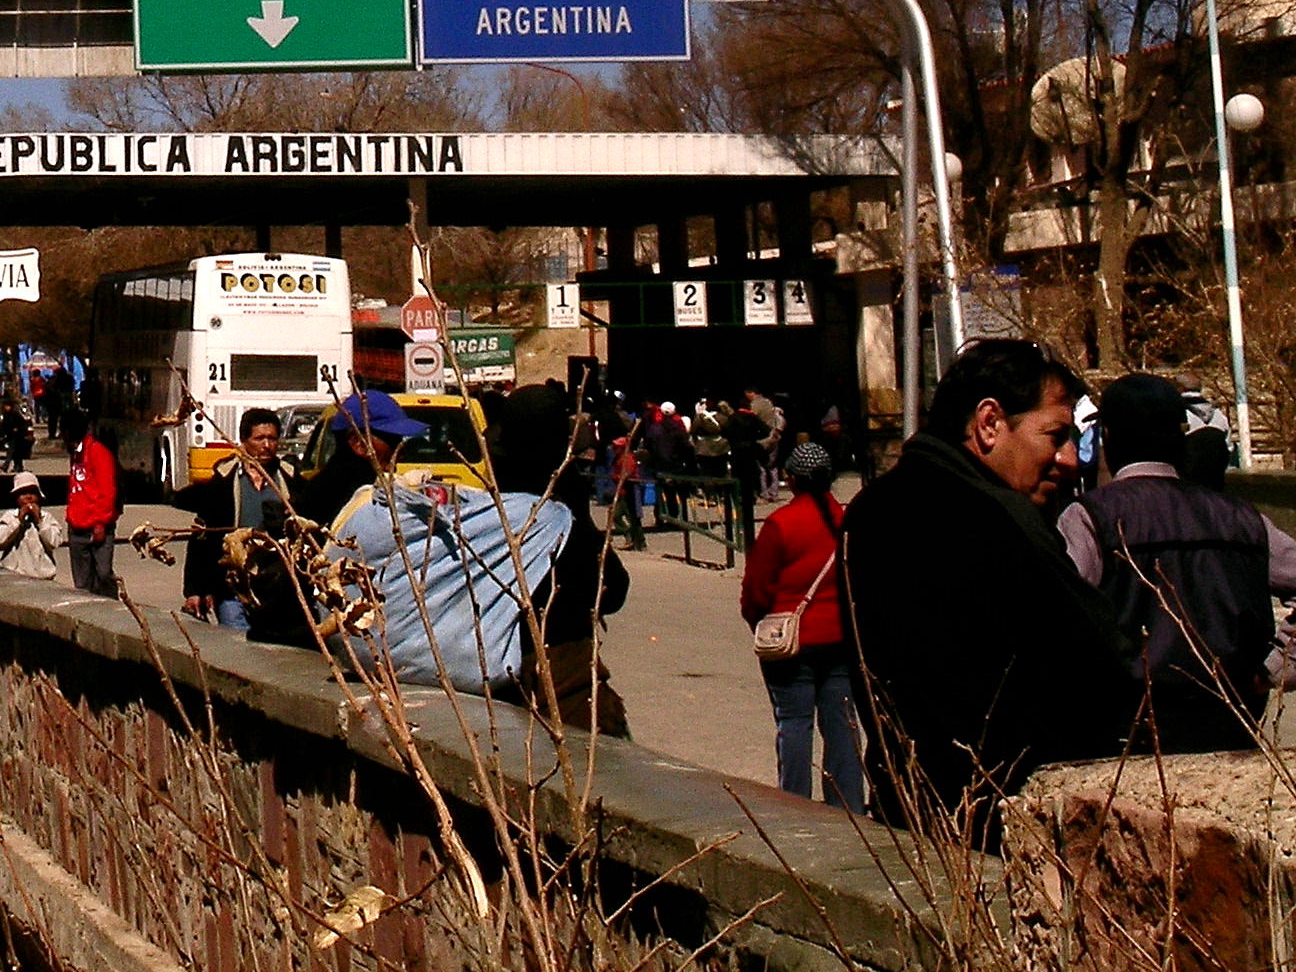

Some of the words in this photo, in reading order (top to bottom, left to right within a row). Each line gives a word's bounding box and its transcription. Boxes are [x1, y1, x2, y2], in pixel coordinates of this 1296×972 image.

[476, 6, 633, 36] ARGENTINA
[224, 135, 465, 173] ARGENTINA
[220, 272, 327, 294] POTOSI
[753, 282, 766, 304] 3
[792, 281, 805, 304] 4
[556, 285, 569, 307] 1
[683, 284, 697, 306] 2
[209, 362, 227, 381] 21
[409, 379, 443, 389] ADUANA
